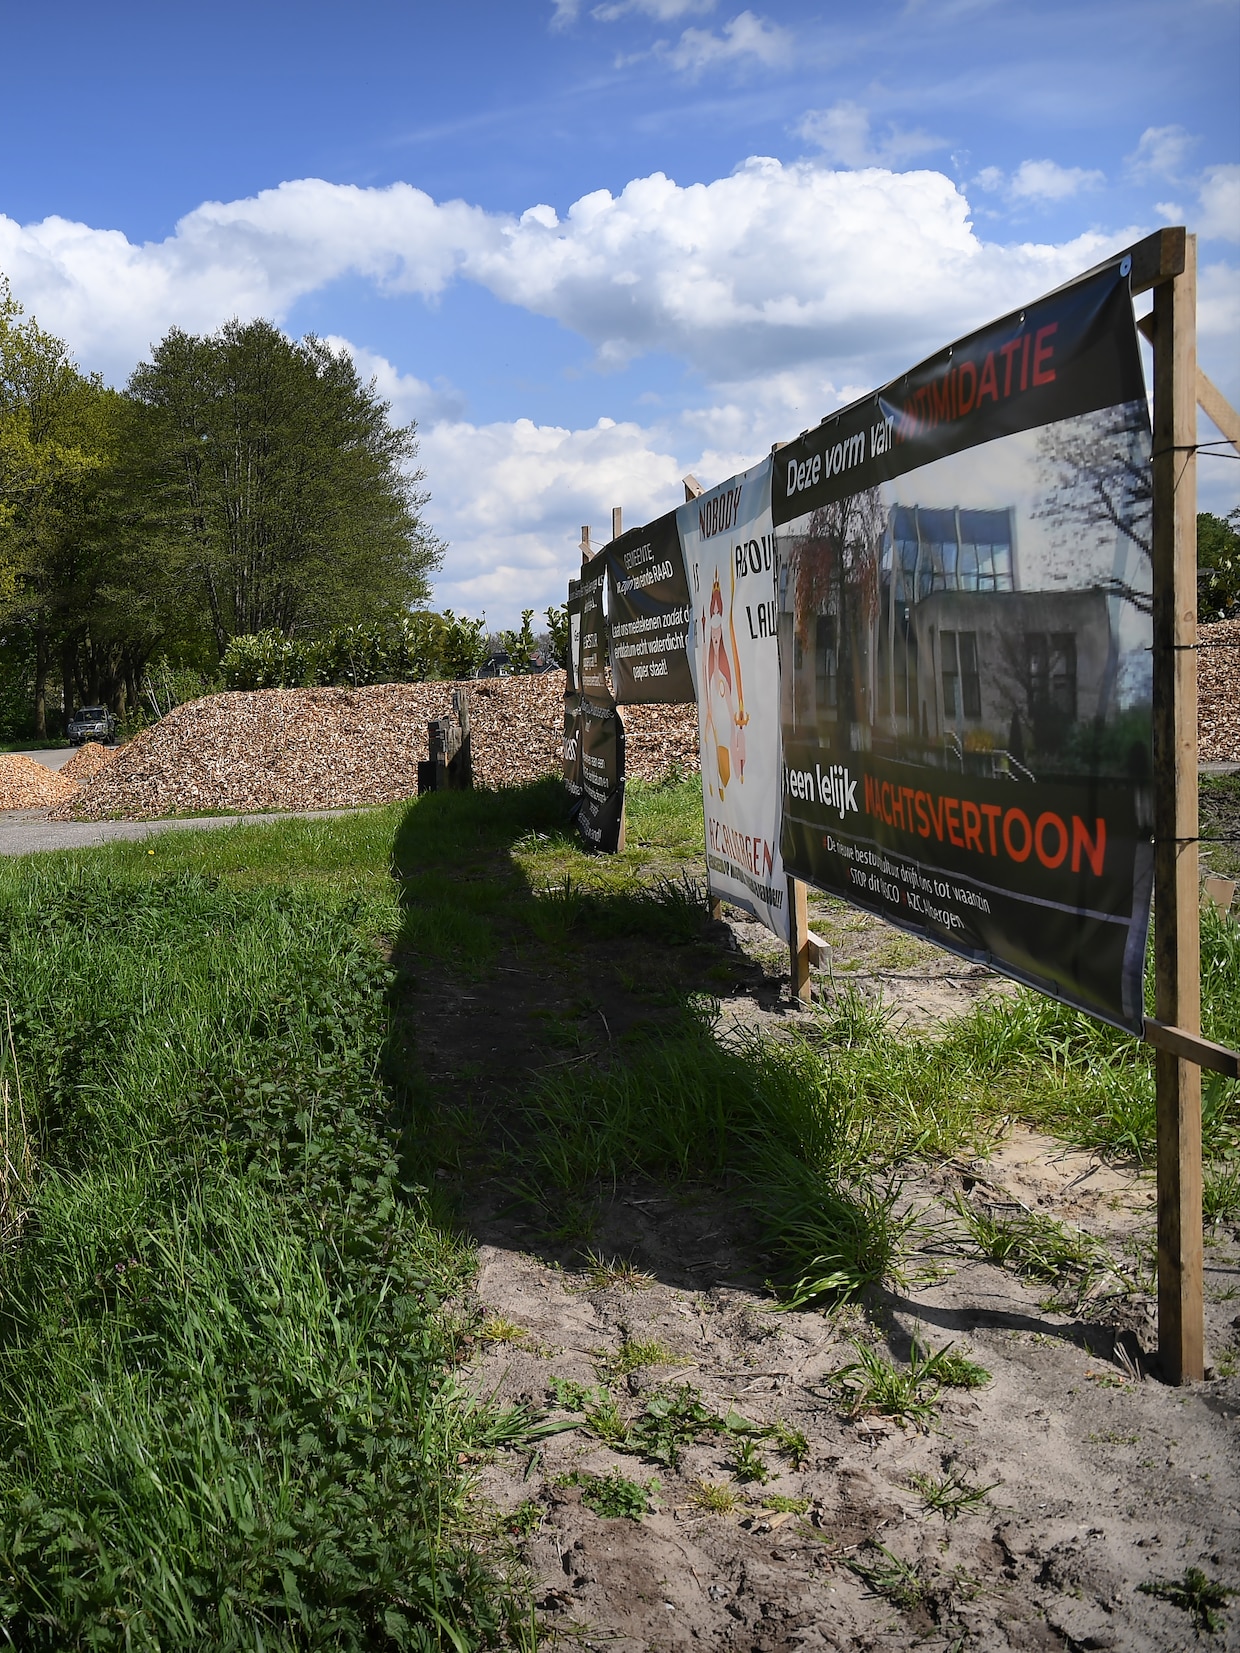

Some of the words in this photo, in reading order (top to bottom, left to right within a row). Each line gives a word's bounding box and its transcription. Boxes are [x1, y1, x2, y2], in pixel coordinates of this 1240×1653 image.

[786, 454, 821, 497] Deze
[825, 431, 866, 479] vorm
[871, 415, 894, 458] van
[895, 321, 1059, 447] INTIMIDATIE
[699, 485, 742, 541] NOBODY
[652, 560, 673, 582] RAAD
[662, 607, 683, 628] zodat
[636, 638, 648, 656] echt
[648, 631, 685, 654] waterdicht
[790, 769, 814, 802] een
[816, 763, 858, 820] lelijk
[836, 840, 855, 860] nieuwe
[900, 863, 919, 889] drijft
[919, 875, 933, 894] ons
[933, 880, 951, 899] tot
[951, 886, 991, 914] waanzin
[868, 873, 881, 894] dit
